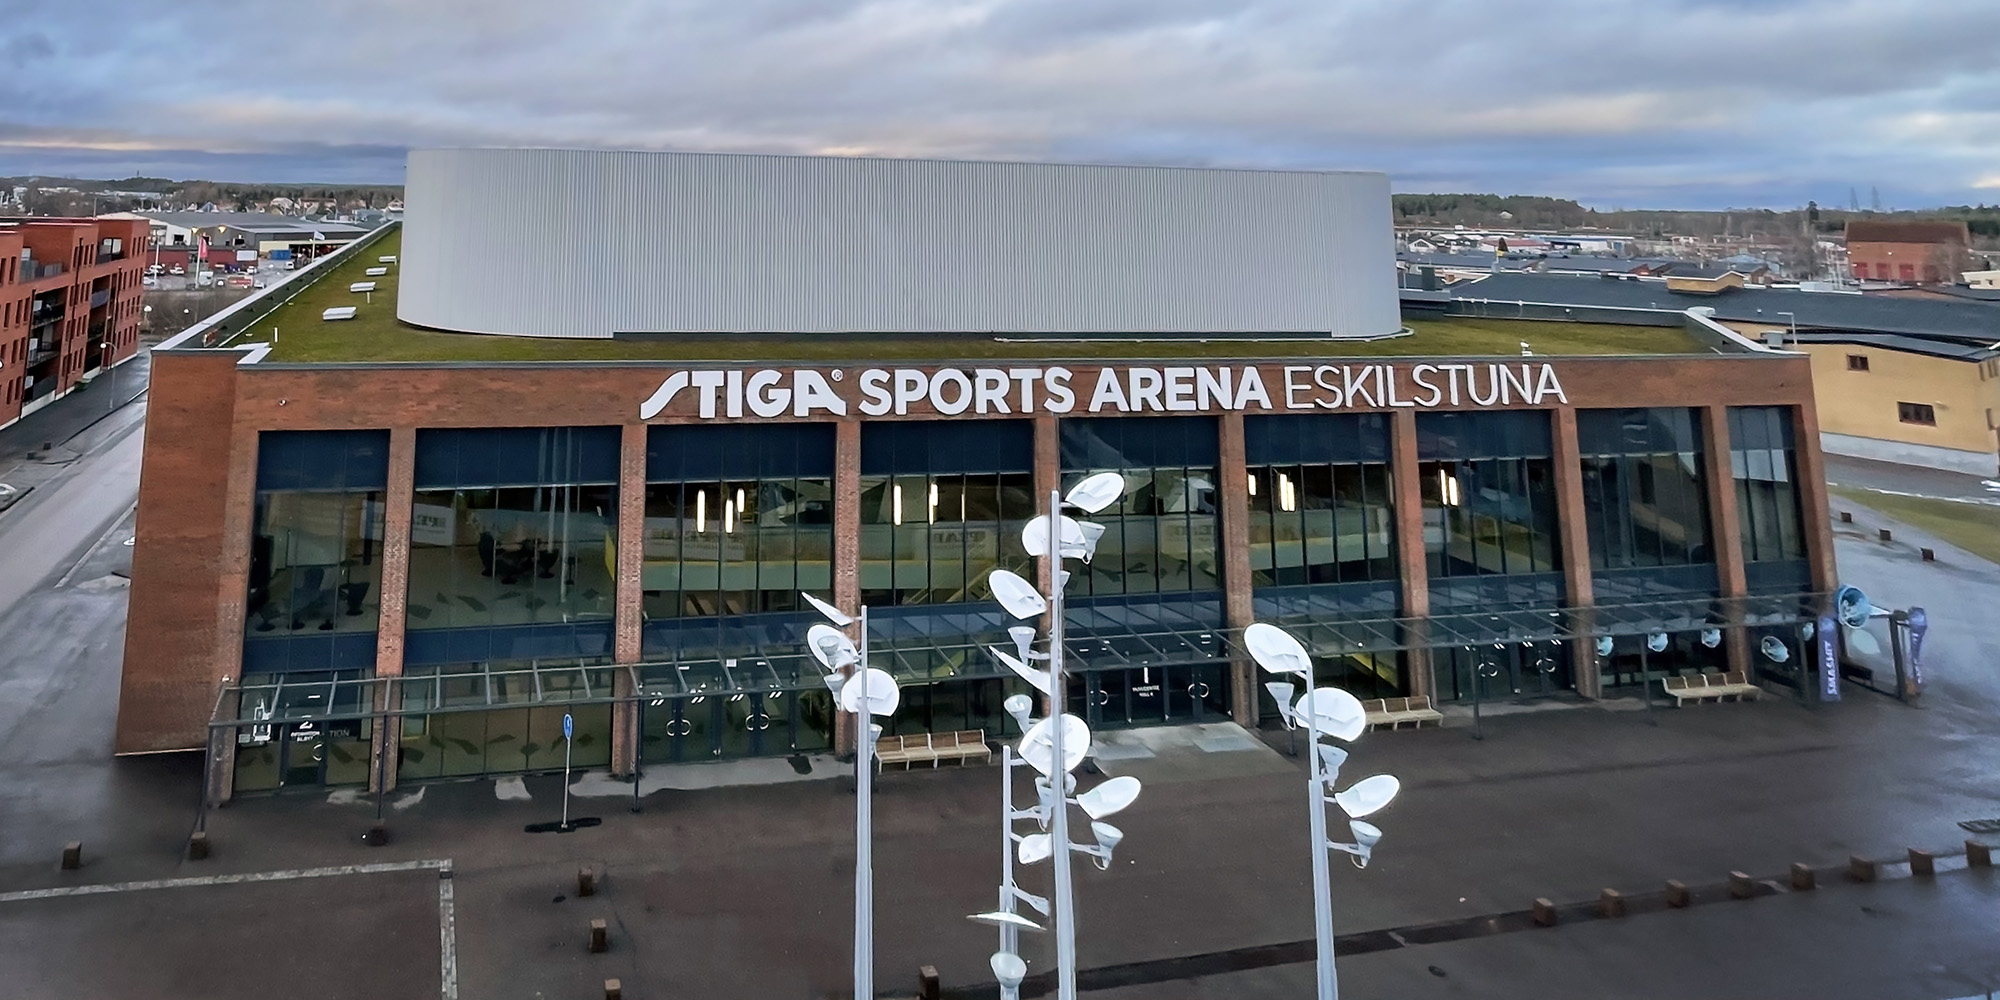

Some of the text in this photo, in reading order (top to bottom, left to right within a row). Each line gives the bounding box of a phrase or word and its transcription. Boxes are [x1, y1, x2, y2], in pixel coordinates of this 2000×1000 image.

[858, 366, 1077, 416] SPORTS
[1088, 366, 1273, 412] ARENA
[1285, 363, 1568, 409] ESKILSTUNA
